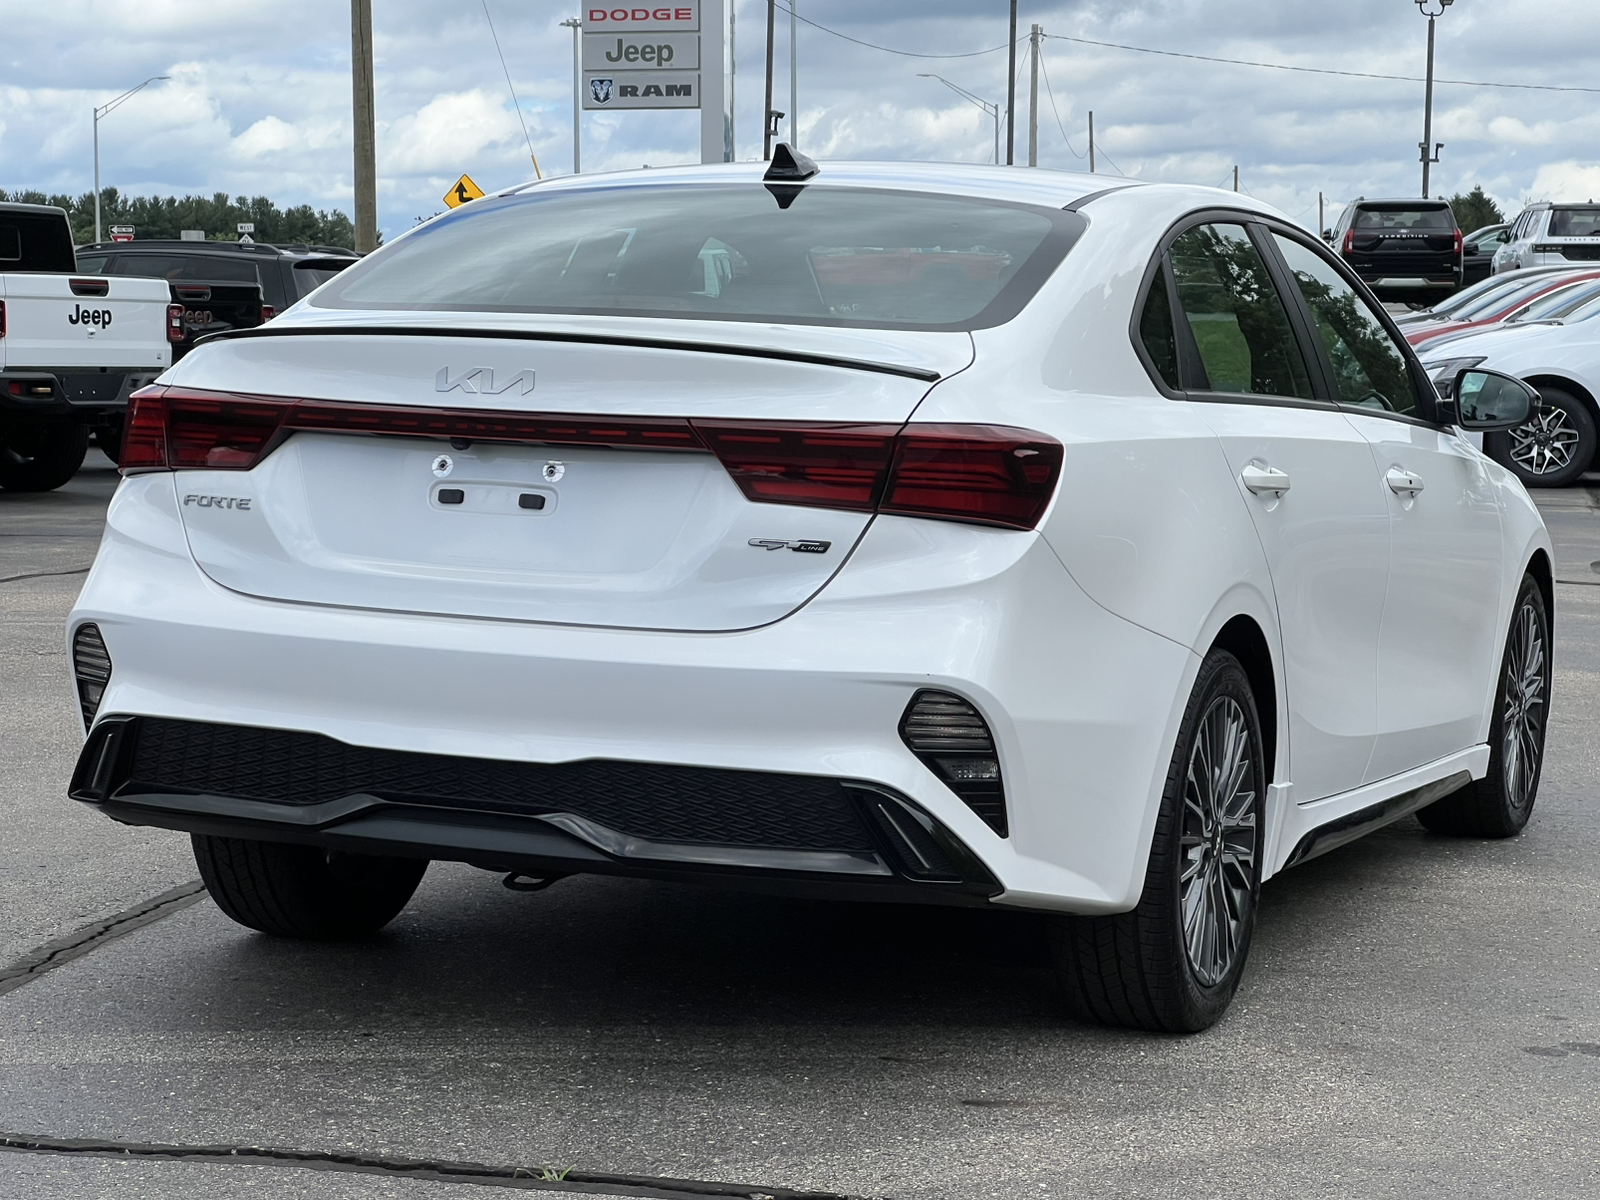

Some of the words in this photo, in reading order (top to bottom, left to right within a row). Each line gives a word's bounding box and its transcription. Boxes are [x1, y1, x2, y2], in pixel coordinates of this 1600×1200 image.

[589, 8, 692, 21] DODGE
[605, 38, 674, 67] Jeep
[619, 84, 692, 97] RAM
[68, 304, 112, 329] Jeep
[184, 310, 213, 327] eep
[435, 365, 536, 397] KIA
[183, 494, 252, 511] FORTE
